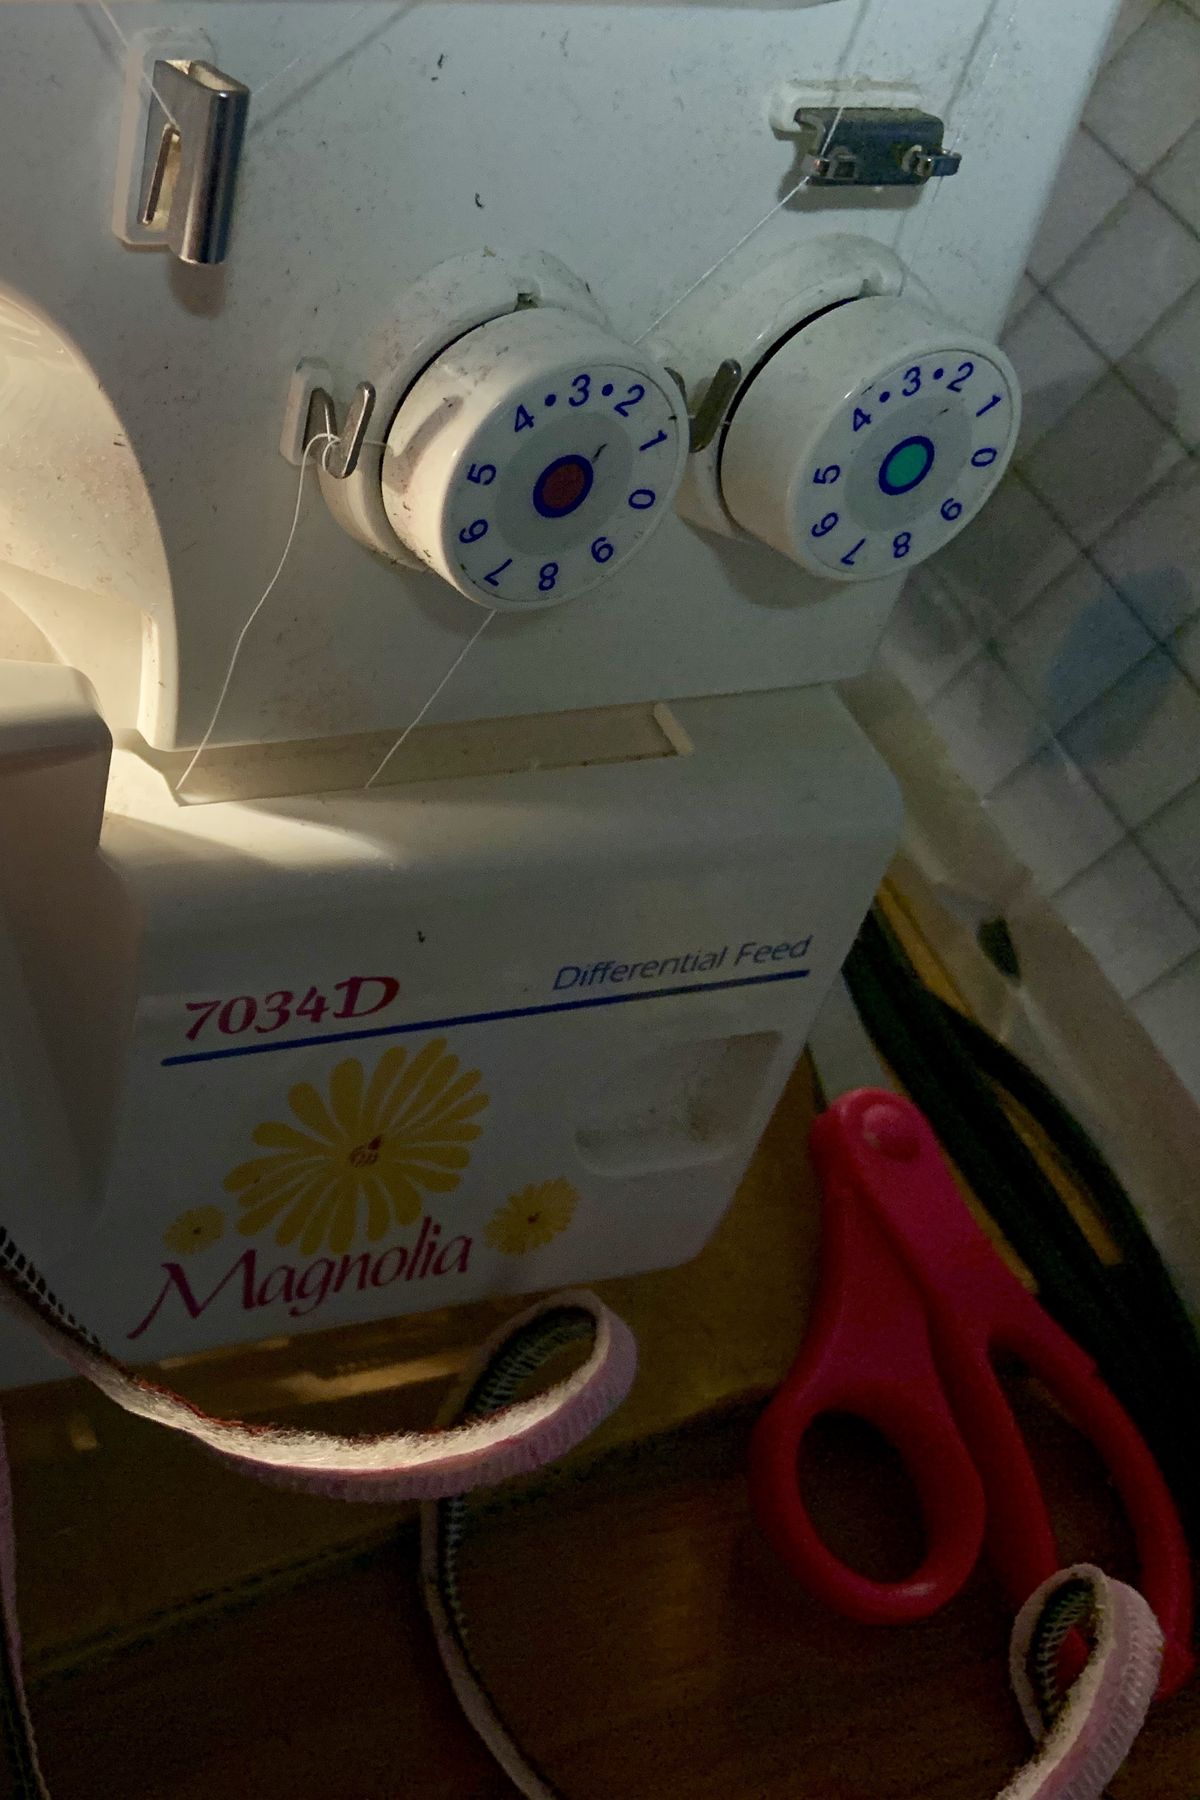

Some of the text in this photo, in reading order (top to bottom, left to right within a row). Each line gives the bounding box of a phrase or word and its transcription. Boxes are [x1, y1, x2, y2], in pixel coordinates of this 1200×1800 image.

[568, 373, 591, 408] 3
[901, 365, 922, 398] 3
[946, 361, 975, 393] 2
[613, 384, 646, 417] 2
[975, 394, 1003, 418] 1
[514, 403, 535, 433] 4
[852, 407, 872, 432] 4
[639, 429, 668, 452] 1
[970, 447, 998, 467] 0
[466, 463, 497, 486] 5
[812, 464, 841, 485] 5
[627, 488, 656, 510] 0
[840, 537, 867, 565] 7
[892, 531, 912, 559] 8
[483, 557, 513, 587] 7
[537, 562, 559, 592] 8
[552, 933, 815, 991] Differential Feed
[184, 975, 401, 1041] 7034D
[125, 1214, 474, 1340] Magnolia
